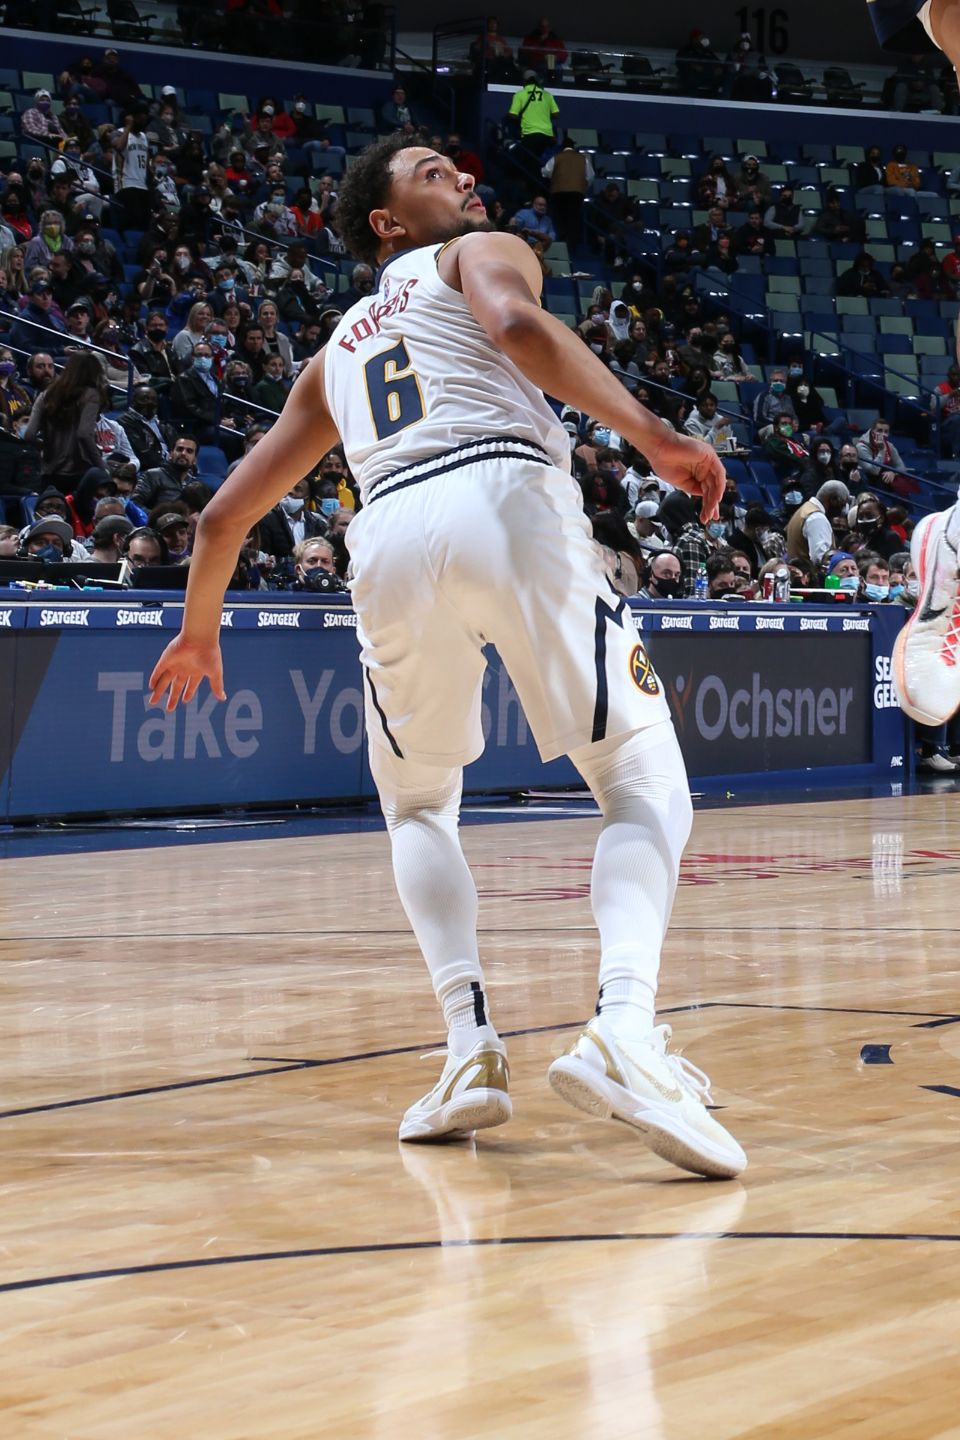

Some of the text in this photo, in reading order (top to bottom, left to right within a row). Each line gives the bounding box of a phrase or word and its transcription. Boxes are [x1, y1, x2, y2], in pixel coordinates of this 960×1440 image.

[735, 6, 789, 54] 116
[362, 336, 427, 442] 6
[40, 609, 89, 626] SEATGEEK
[116, 609, 164, 626] SEATGEEK
[257, 611, 301, 627] SEATGEEK
[661, 615, 693, 629] SEATGEEK
[709, 616, 740, 630] SEATGEEK
[755, 617, 785, 630] SEATGEEK
[799, 618, 828, 631] SEATGEEK
[842, 618, 870, 631] SEATGEEK
[873, 683, 901, 709] GEE
[695, 672, 853, 741] Ochsner
[98, 671, 263, 762] Take
